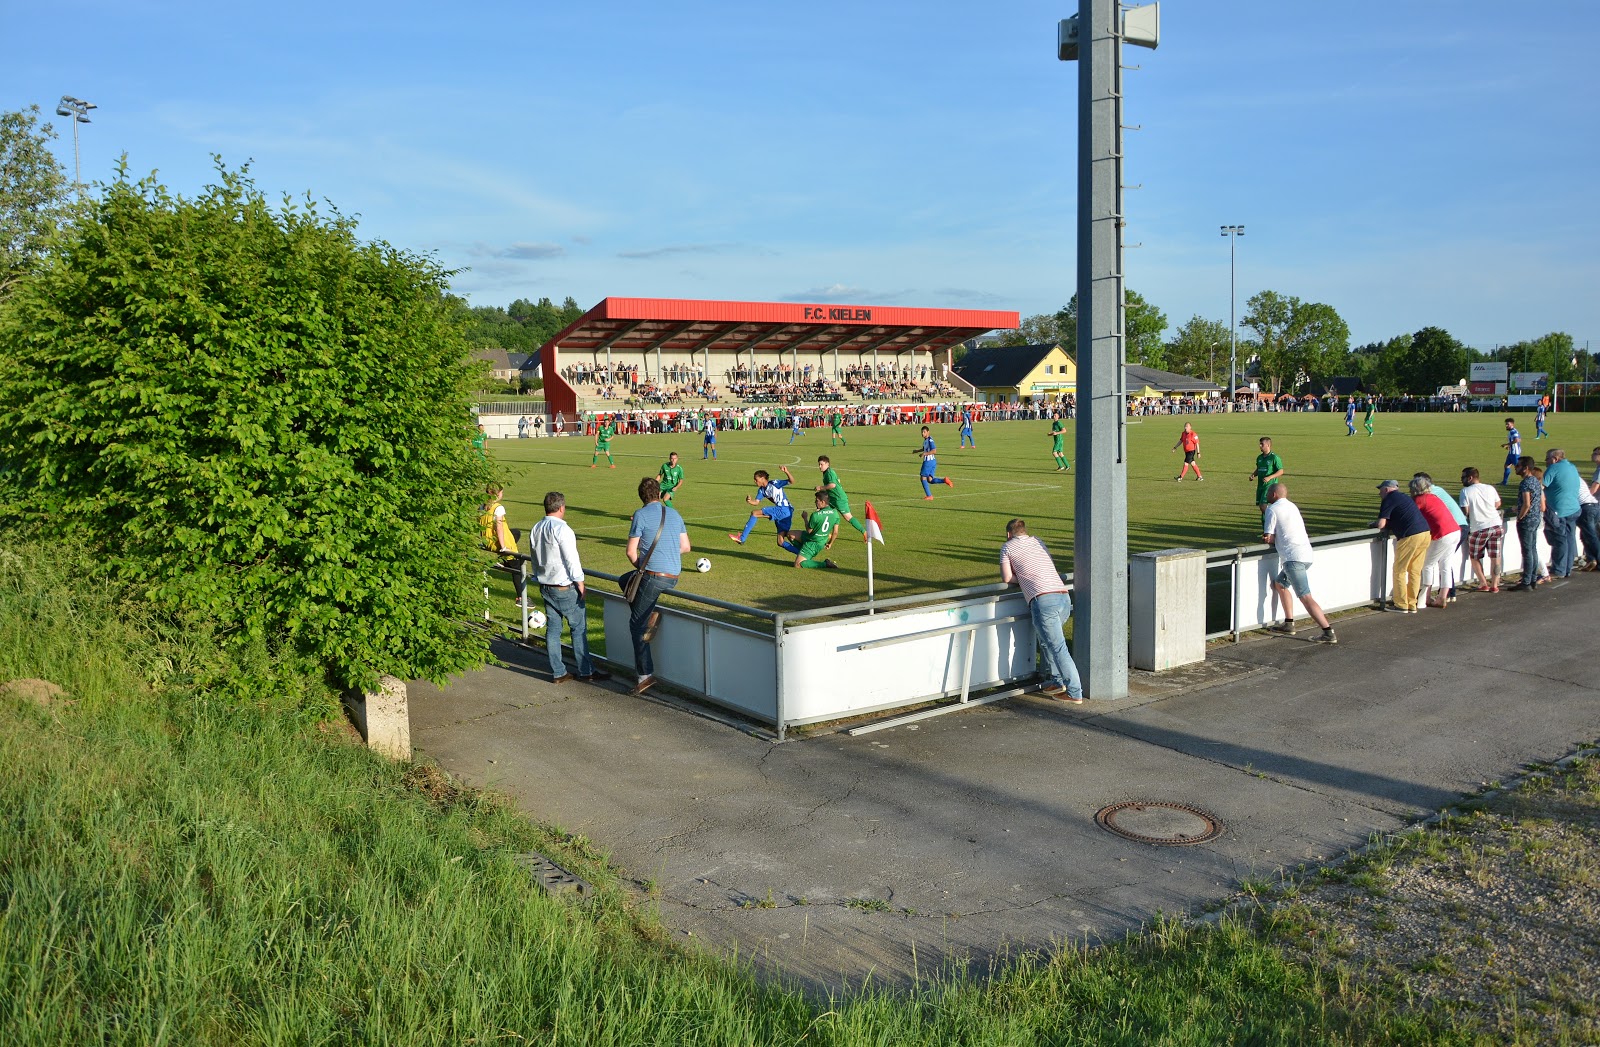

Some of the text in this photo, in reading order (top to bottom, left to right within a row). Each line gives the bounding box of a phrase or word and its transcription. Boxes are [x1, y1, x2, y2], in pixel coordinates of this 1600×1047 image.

[804, 307, 871, 321] F.C. KIELEN
[822, 516, 830, 532] 6
